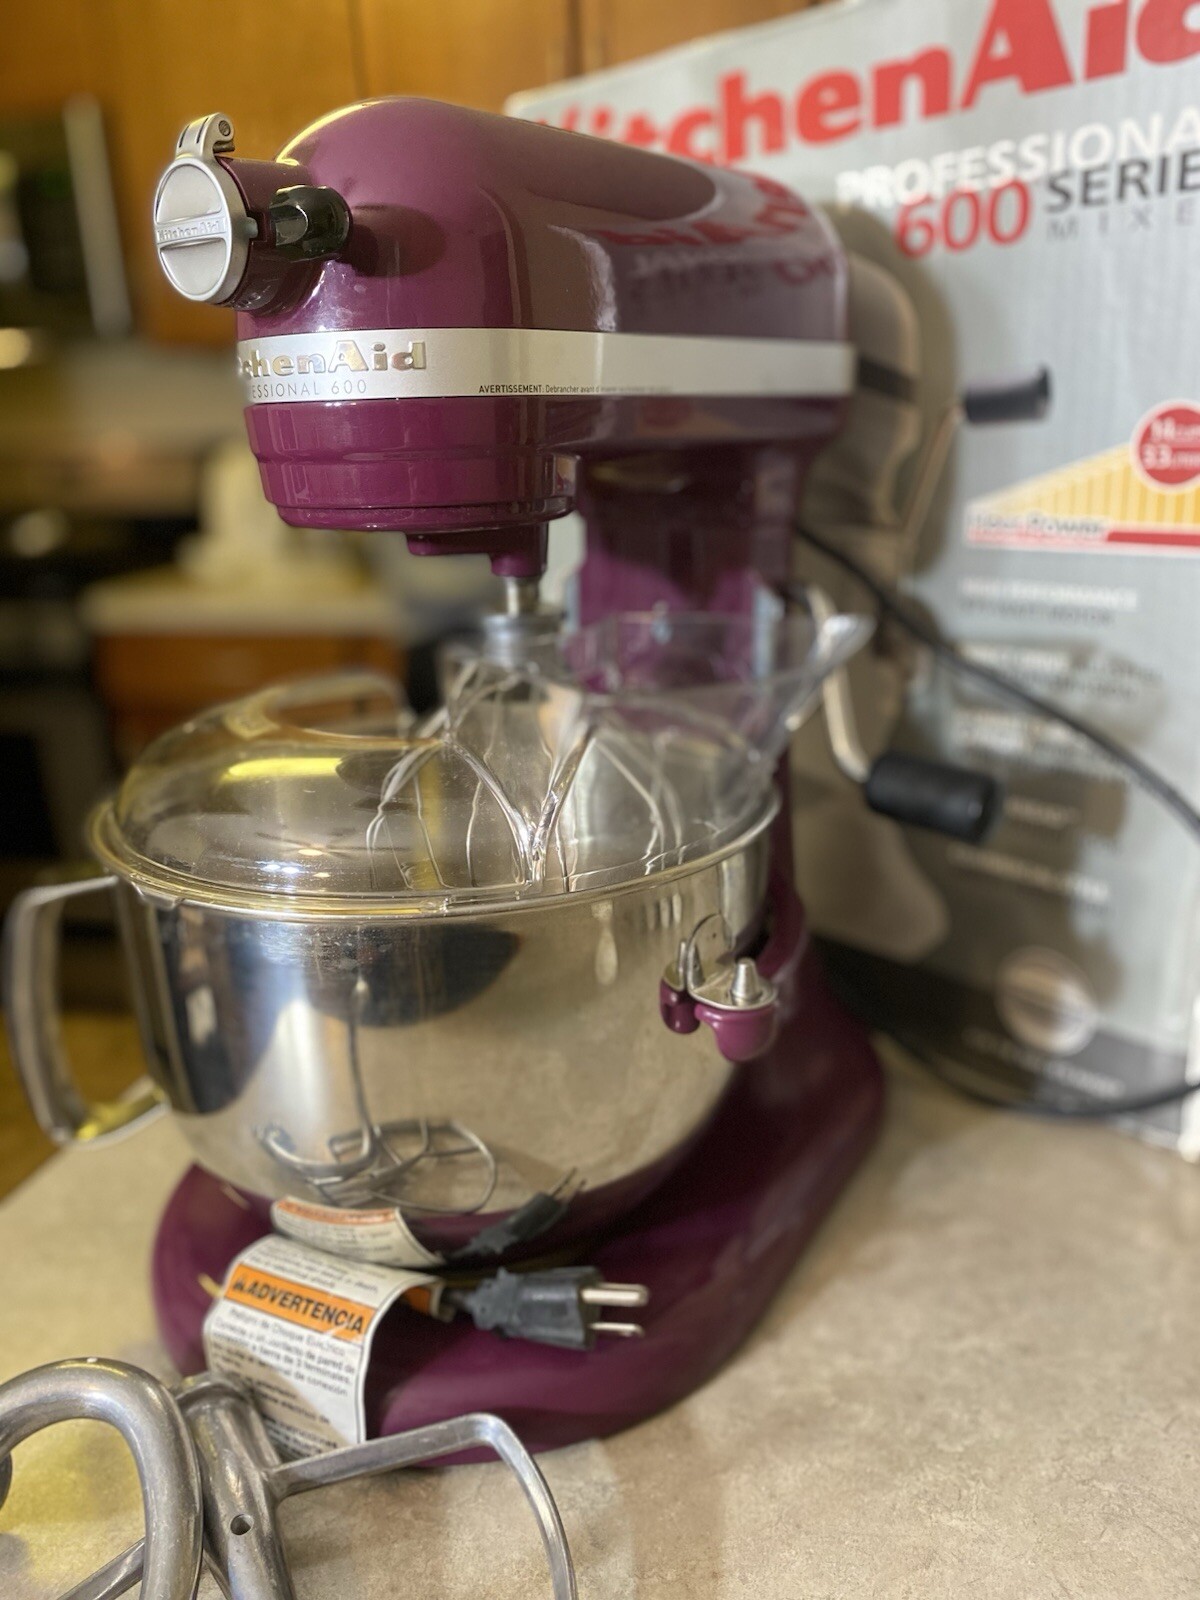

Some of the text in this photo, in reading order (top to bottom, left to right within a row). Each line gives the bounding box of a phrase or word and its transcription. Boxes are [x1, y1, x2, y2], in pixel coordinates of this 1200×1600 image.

[537, 0, 1200, 167] chenAi
[894, 177, 1032, 260] 600
[331, 380, 367, 395] 600
[479, 384, 545, 394] AVERTISSEMENT:
[248, 1281, 365, 1334] ADVERTENCIA
